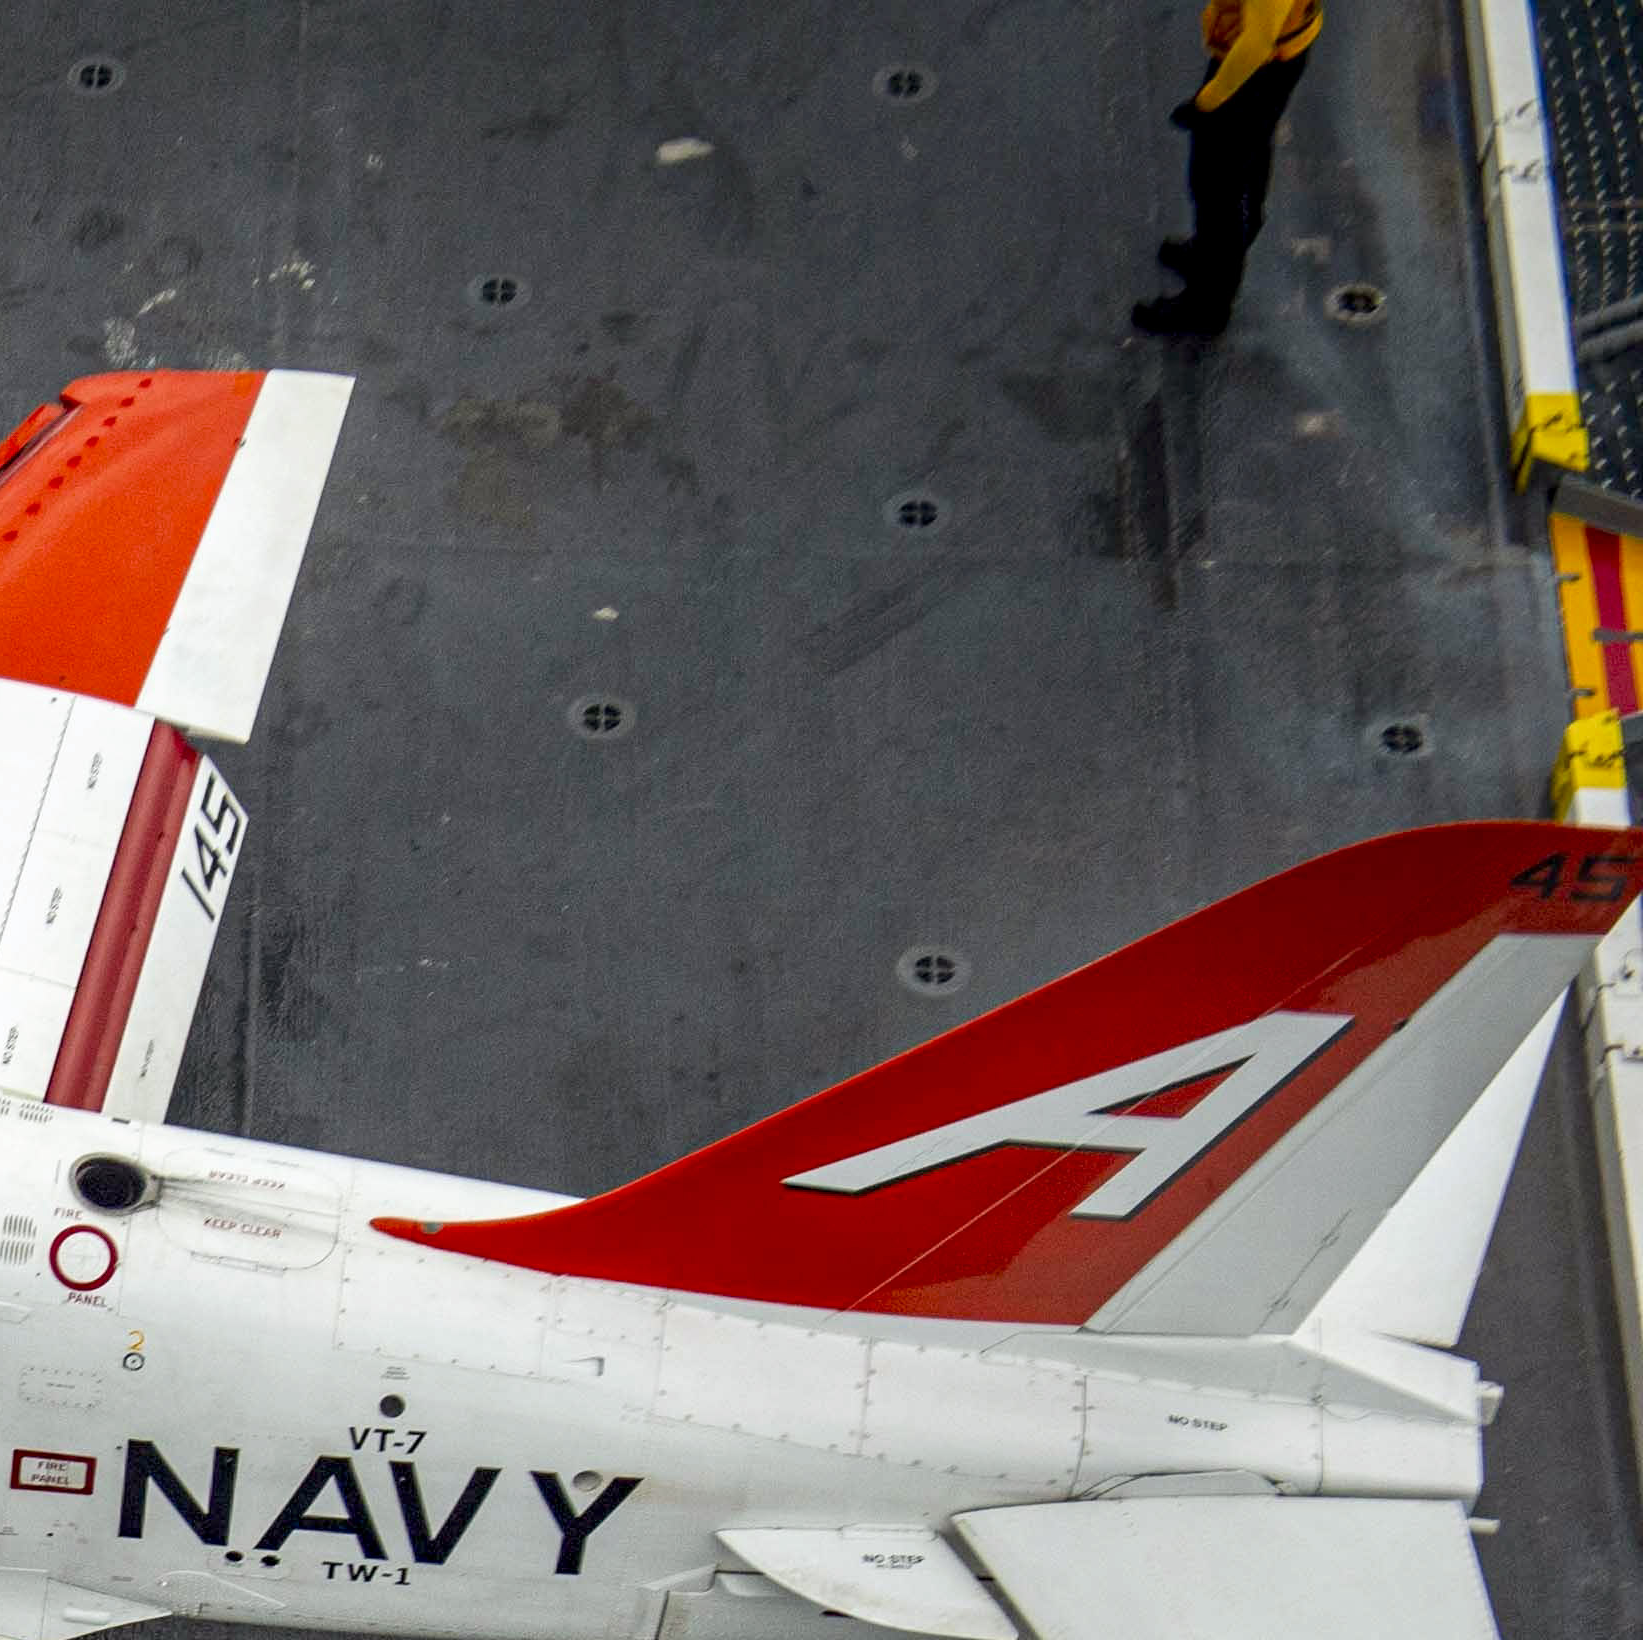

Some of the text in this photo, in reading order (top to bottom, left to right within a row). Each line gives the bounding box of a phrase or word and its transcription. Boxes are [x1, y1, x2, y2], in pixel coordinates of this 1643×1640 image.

[181, 772, 241, 922] 145
[1510, 851, 1635, 902] 45
[780, 1009, 1355, 1221] A
[53, 1207, 84, 1220] FIRE
[67, 1291, 108, 1308] PANEL
[128, 1329, 145, 1350] 2
[1193, 1418, 1228, 1432] STEP
[348, 1426, 428, 1455] VT-7
[38, 1460, 68, 1472] FIRE
[31, 1473, 70, 1485] PANEL
[117, 1438, 645, 1575] NAVY
[321, 1561, 412, 1586] TW-1
